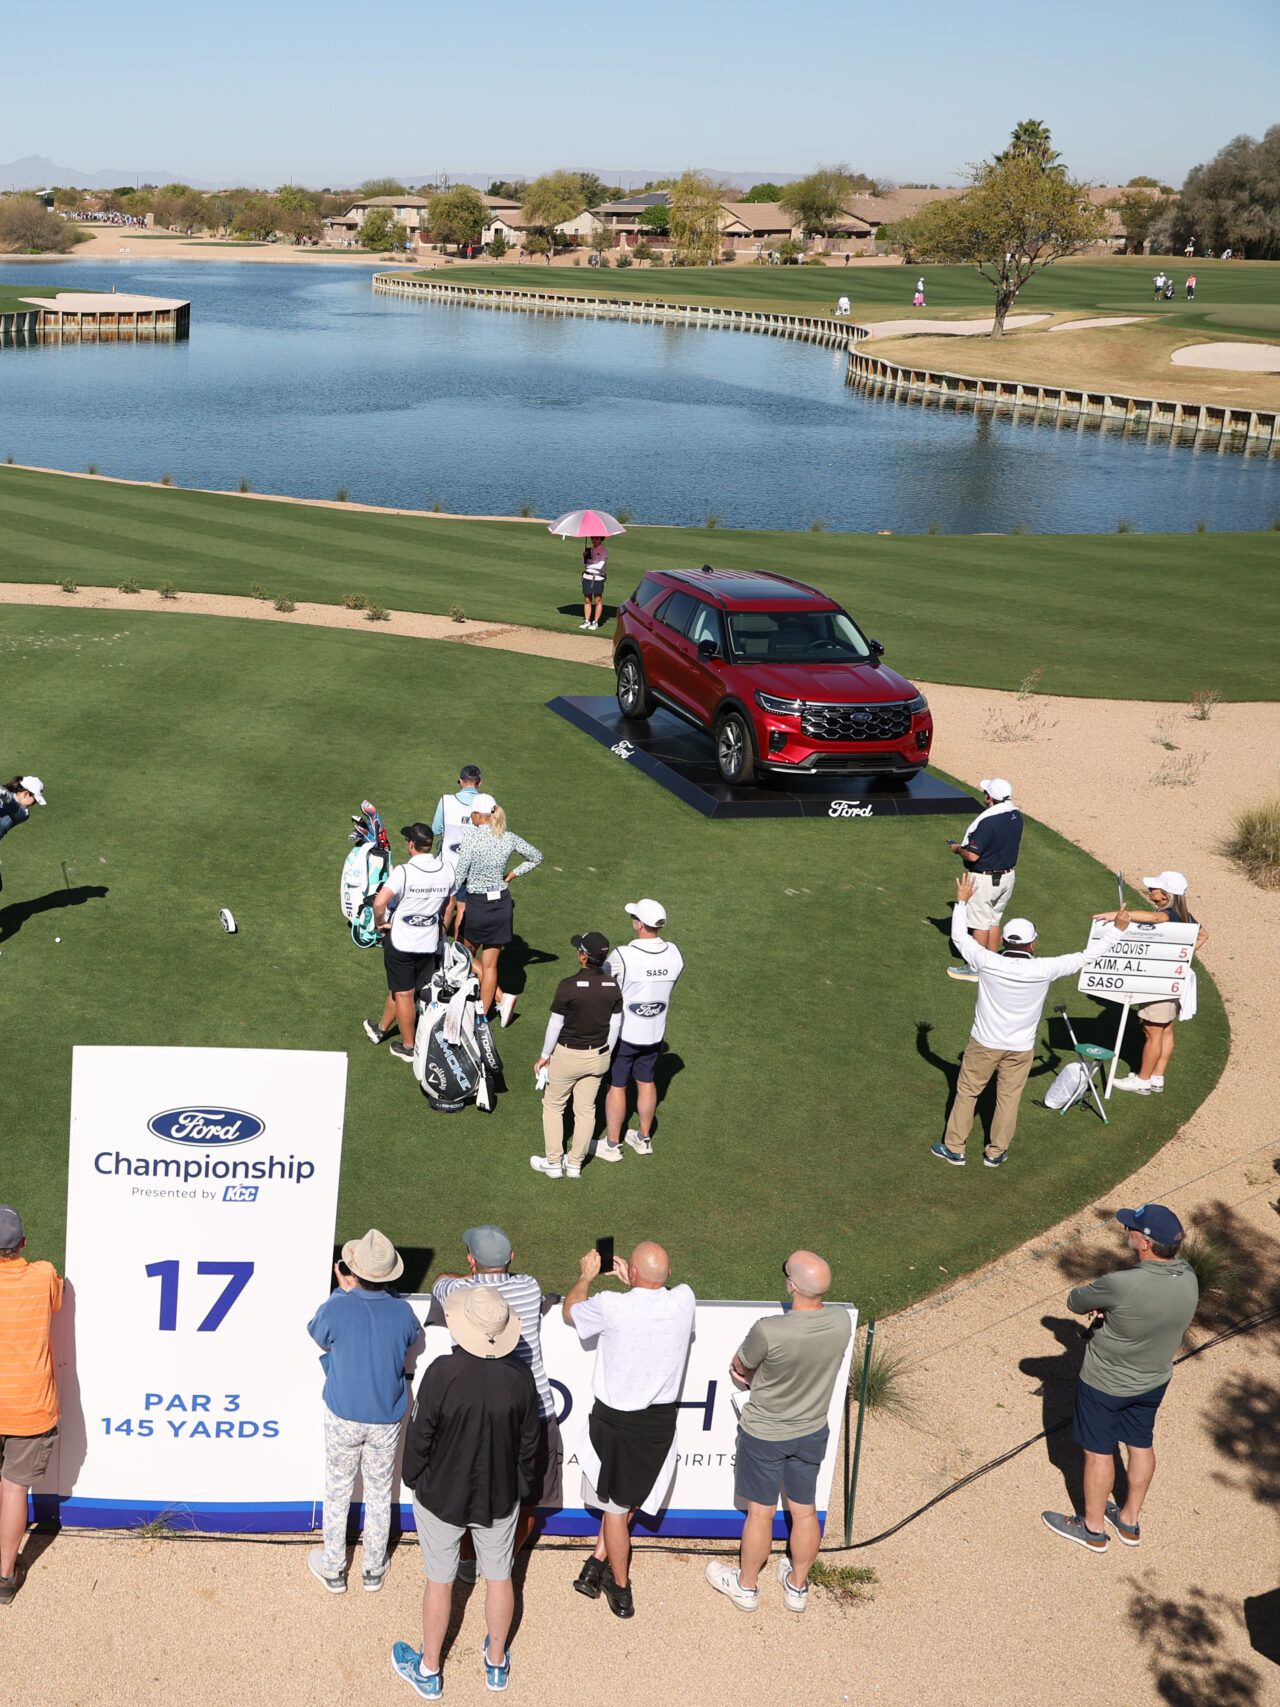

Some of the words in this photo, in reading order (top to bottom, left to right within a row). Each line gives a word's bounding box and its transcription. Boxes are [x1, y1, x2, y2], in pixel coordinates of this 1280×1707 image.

[611, 740, 635, 759] Ford
[828, 800, 873, 817] Ford
[1179, 948, 1188, 958] 5
[646, 969, 668, 977] SASO
[1094, 959, 1119, 972] KIM,
[1123, 961, 1146, 972] A.L.
[1174, 965, 1183, 975] 4
[1087, 976, 1124, 989] SASO
[1171, 982, 1180, 993] 6
[636, 1003, 662, 1016] Ford
[434, 1030, 472, 1092] SMOKE
[428, 1062, 448, 1091] Callaway
[171, 1111, 242, 1139] Ford
[94, 1151, 315, 1183] Championship
[132, 1187, 196, 1199] Presented
[202, 1188, 216, 1200] by
[226, 1185, 257, 1201] KCC
[145, 1260, 255, 1332] 17
[144, 1393, 211, 1412] PAR
[223, 1394, 240, 1412] 3
[101, 1418, 154, 1437] 145
[167, 1420, 280, 1438] YARDS
